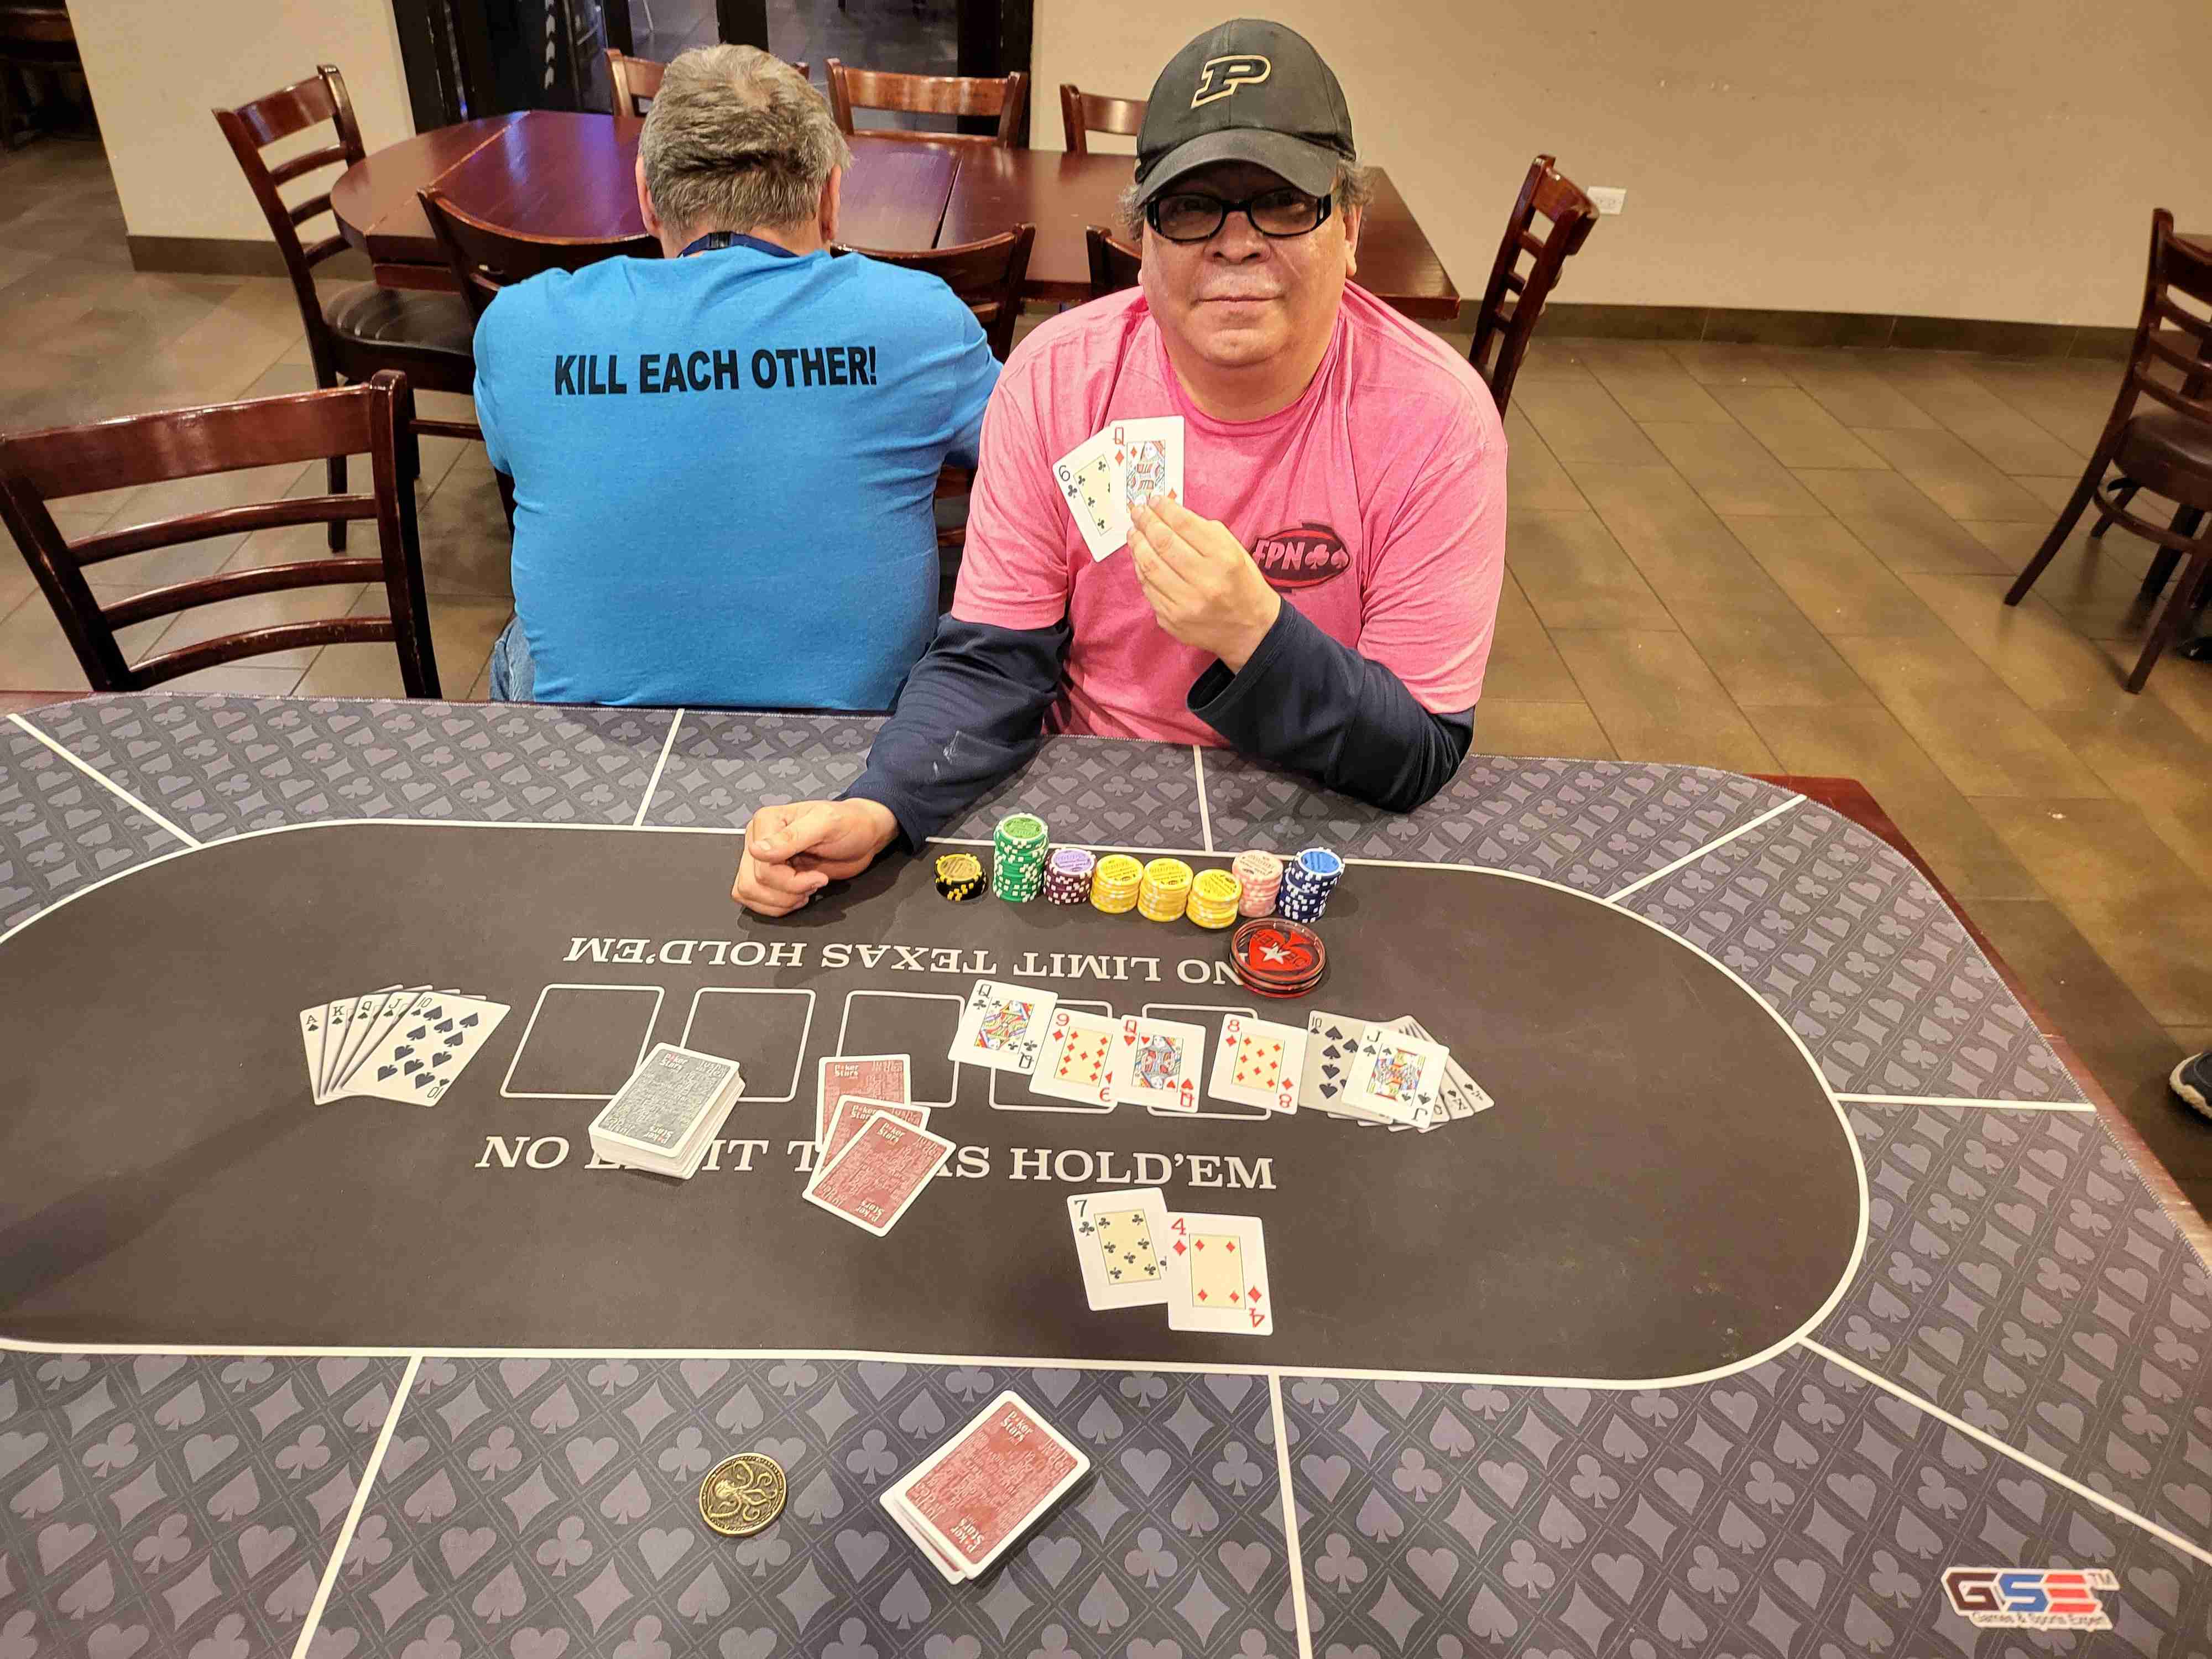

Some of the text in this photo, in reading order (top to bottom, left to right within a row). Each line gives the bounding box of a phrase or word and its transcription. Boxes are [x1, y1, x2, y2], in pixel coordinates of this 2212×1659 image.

[1190, 54, 1272, 109] P
[555, 346, 877, 395] KILL EACH OTHER!
[1112, 426, 1125, 446] Q
[1058, 465, 1071, 482] 6
[562, 937, 1248, 986] NO LIMIT TEXAS HOLD'EM
[977, 984, 992, 999] Q
[1055, 1013, 1070, 1027] 9
[1123, 1020, 1138, 1035] Q
[1227, 1019, 1240, 1032] 8
[1277, 1094, 1292, 1109] 8
[474, 1136, 570, 1169] NO
[584, 1139, 769, 1172] LIT
[1009, 1147, 1277, 1190] HOLD'EM
[1074, 1199, 1088, 1218] 7
[1171, 1217, 1187, 1236] 4
[1249, 1307, 1266, 1328] 4
[1945, 1572, 2098, 1613] GSE
